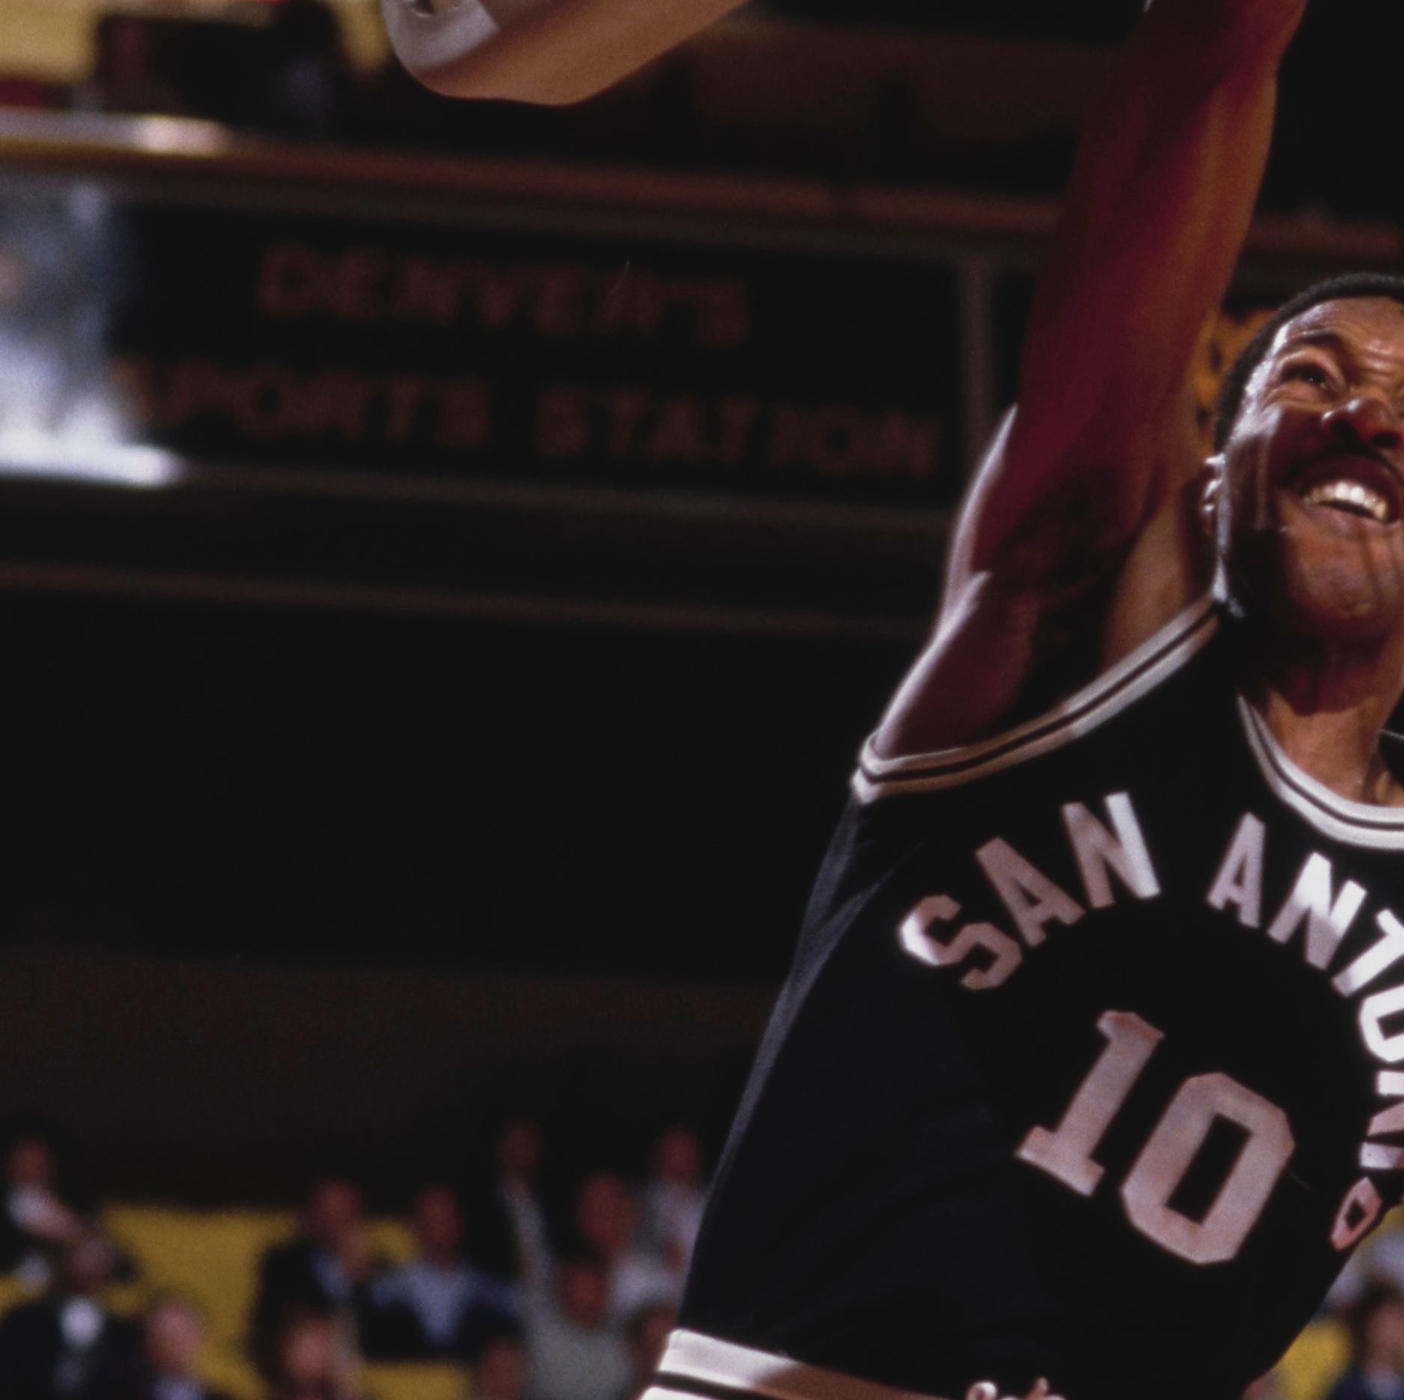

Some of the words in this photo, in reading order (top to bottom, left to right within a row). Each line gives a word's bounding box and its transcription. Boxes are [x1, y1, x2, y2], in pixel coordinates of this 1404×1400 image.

[254, 240, 754, 349] DENVER'S
[535, 384, 944, 480] STATION
[899, 792, 1161, 991] SAN
[1014, 1010, 1295, 1264] 10
